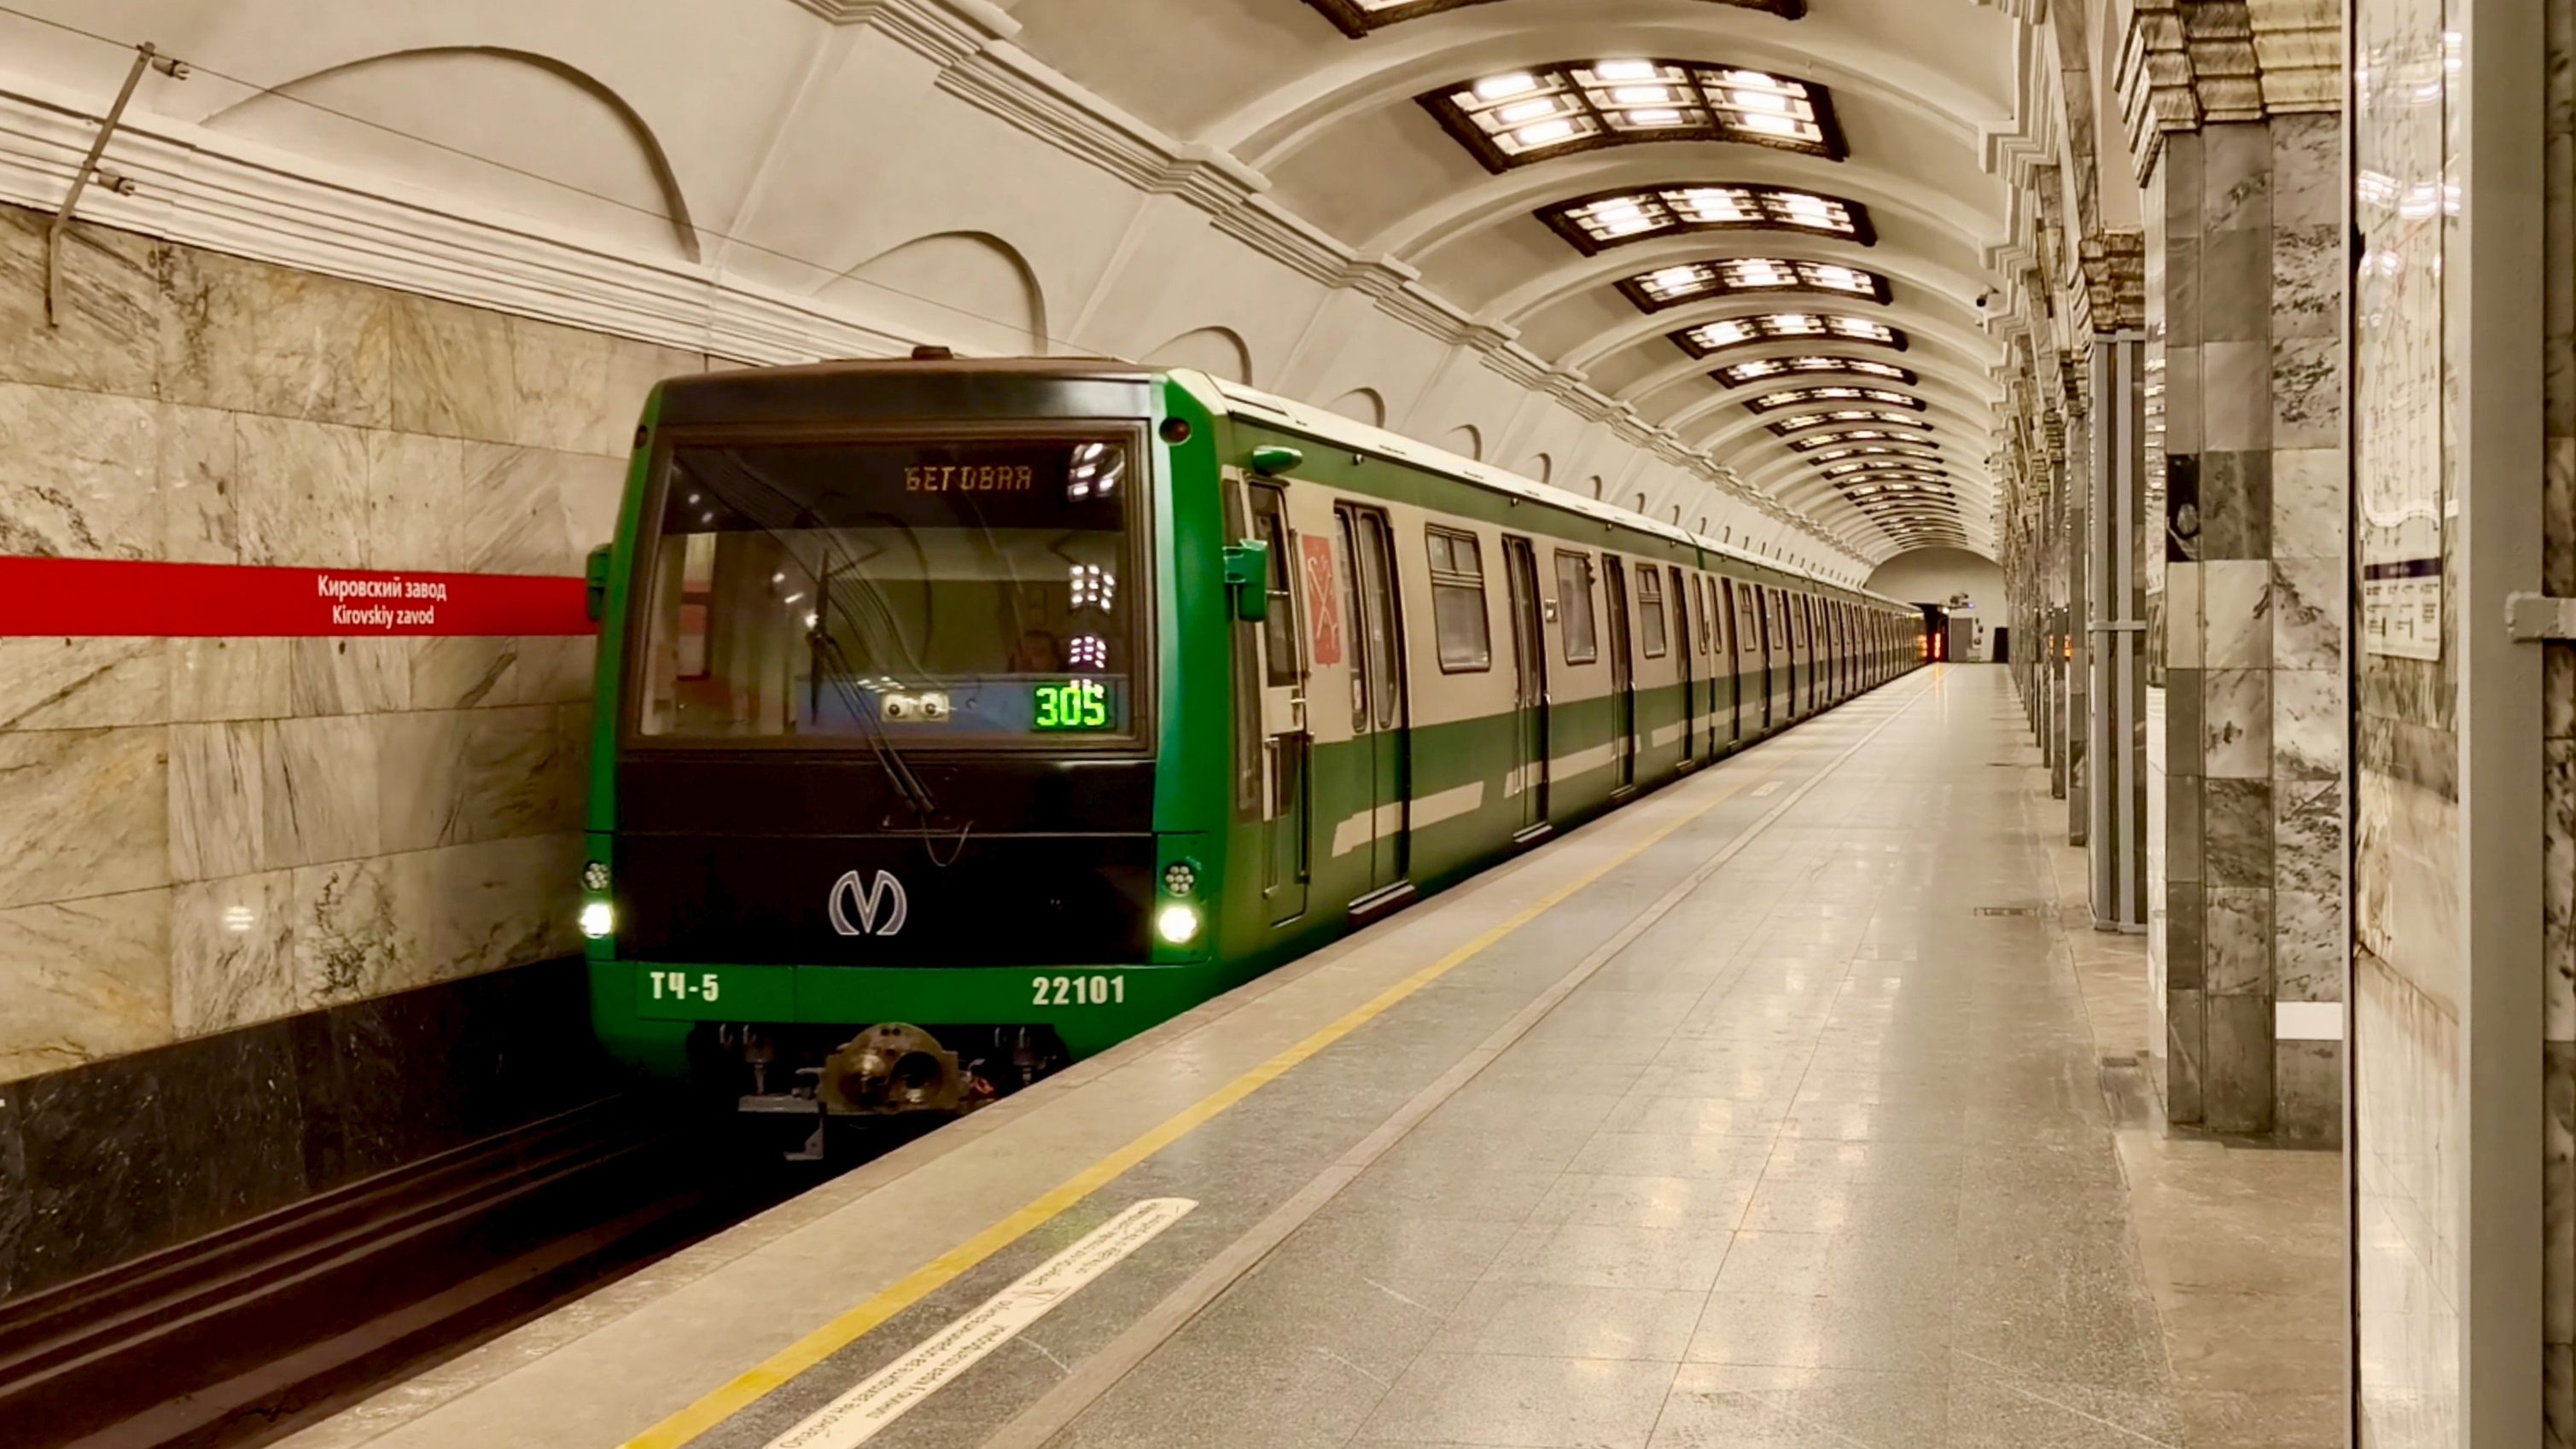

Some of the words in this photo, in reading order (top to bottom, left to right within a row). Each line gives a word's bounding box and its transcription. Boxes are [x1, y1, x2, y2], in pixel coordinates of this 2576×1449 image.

[905, 466, 1032, 492] БЕГОВАЯ
[317, 574, 402, 602] Кировский
[405, 582, 447, 602] завод
[333, 604, 394, 630] Kirovskiy
[396, 605, 434, 625] zavod
[1035, 684, 1105, 726] 305
[650, 971, 720, 1002] ТЧ-5
[1031, 975, 1125, 1005] 22101
